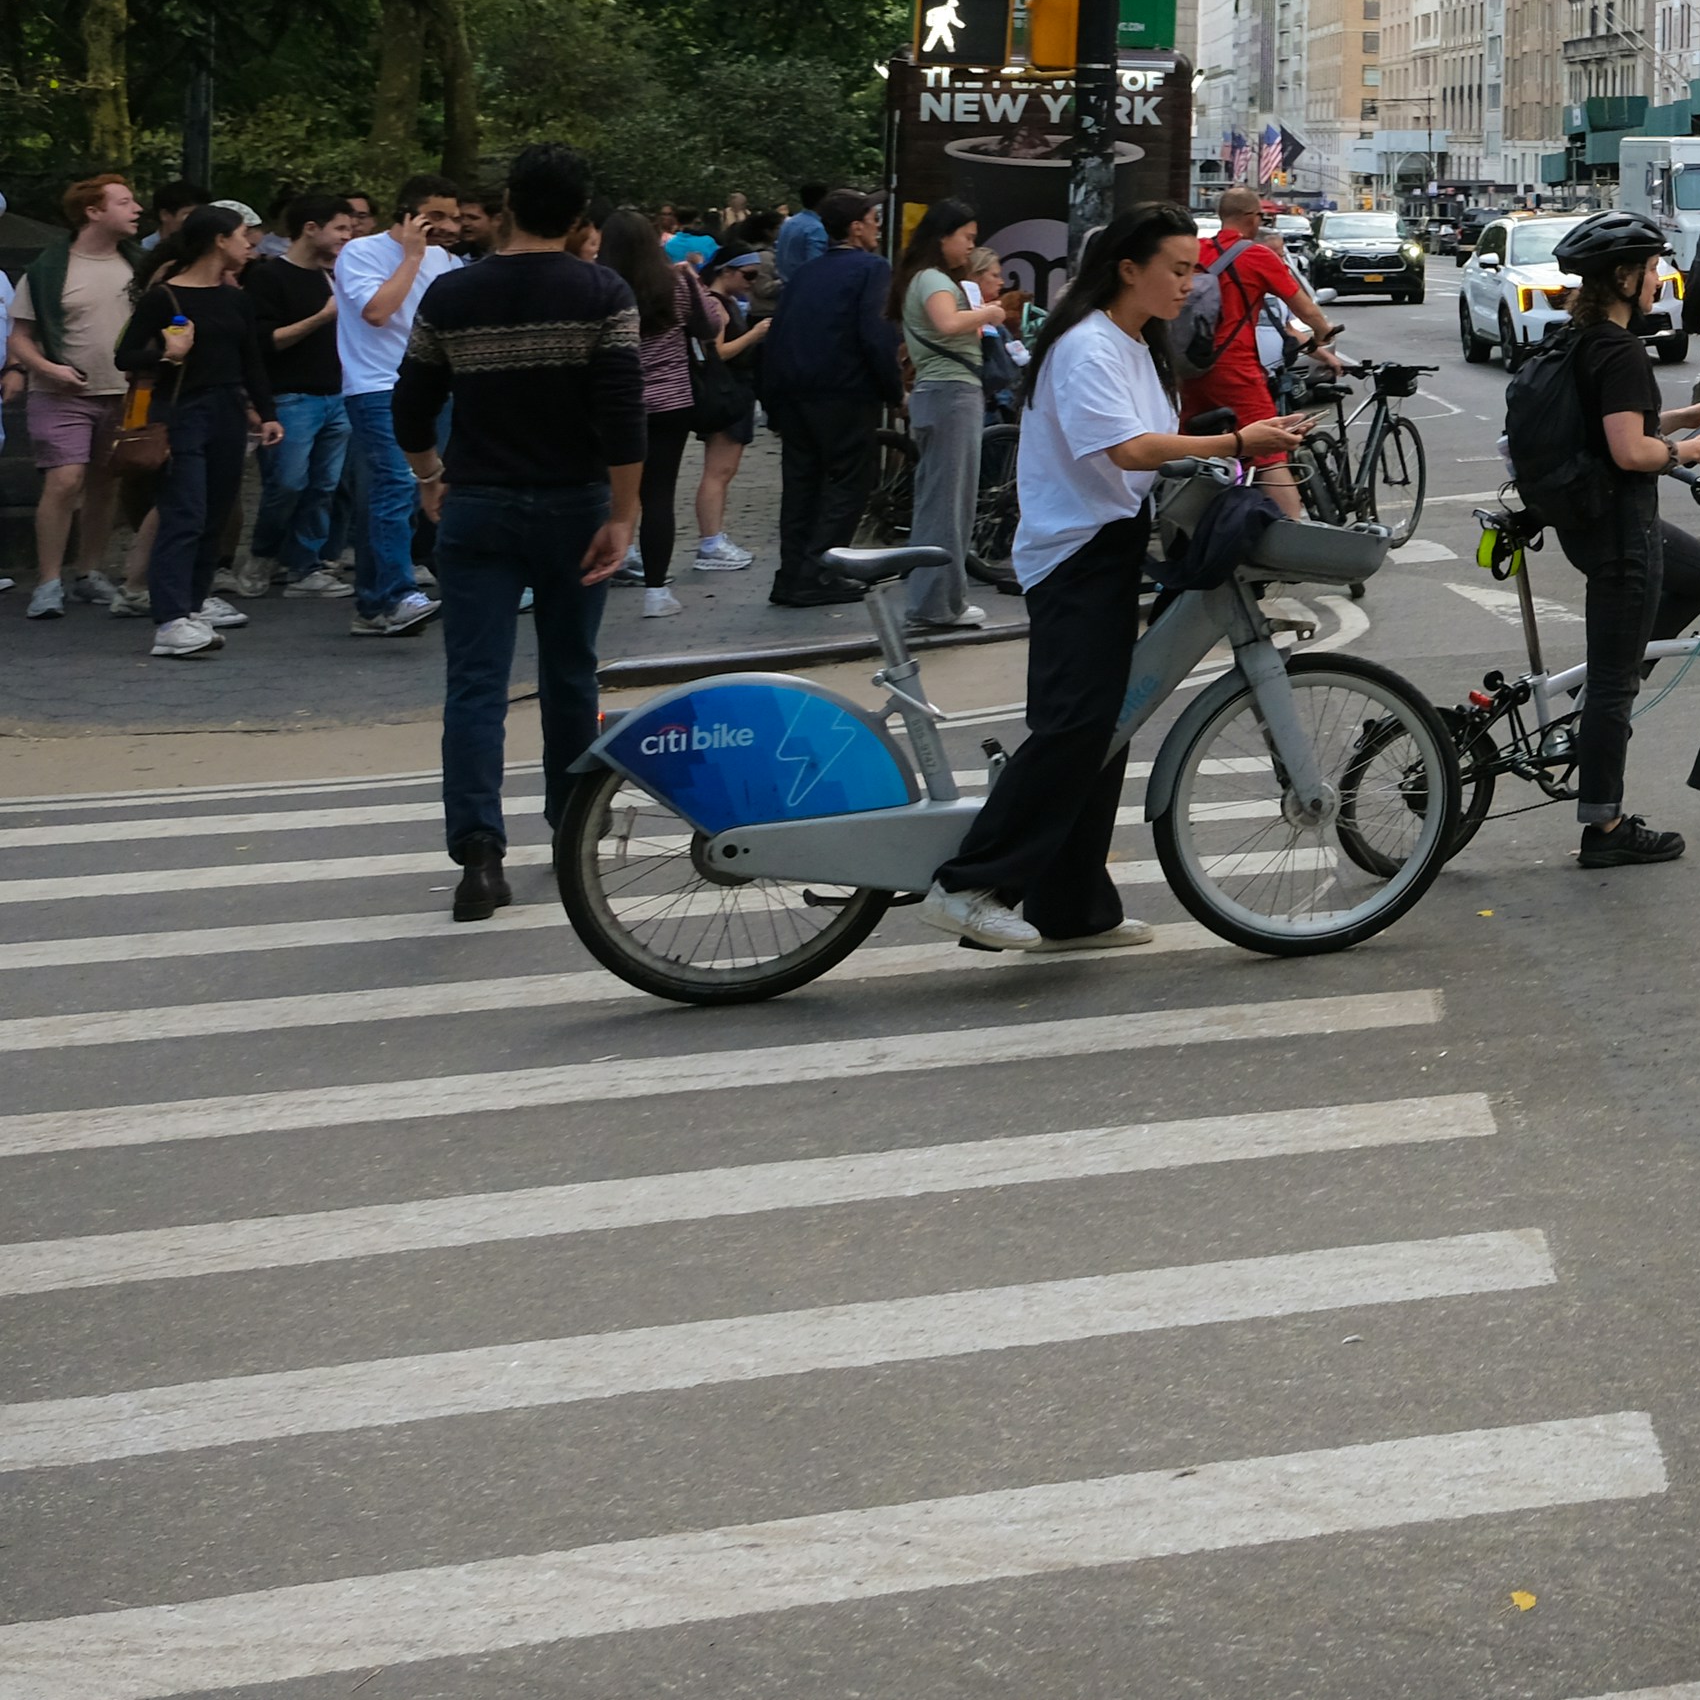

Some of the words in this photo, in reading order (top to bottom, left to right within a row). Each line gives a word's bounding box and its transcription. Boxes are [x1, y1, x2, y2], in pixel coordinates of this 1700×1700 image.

[1121, 72, 1165, 93] OF
[919, 92, 1029, 123] NEW
[1040, 94, 1164, 126] YRK
[640, 726, 687, 755] citi
[691, 723, 755, 750] bike
